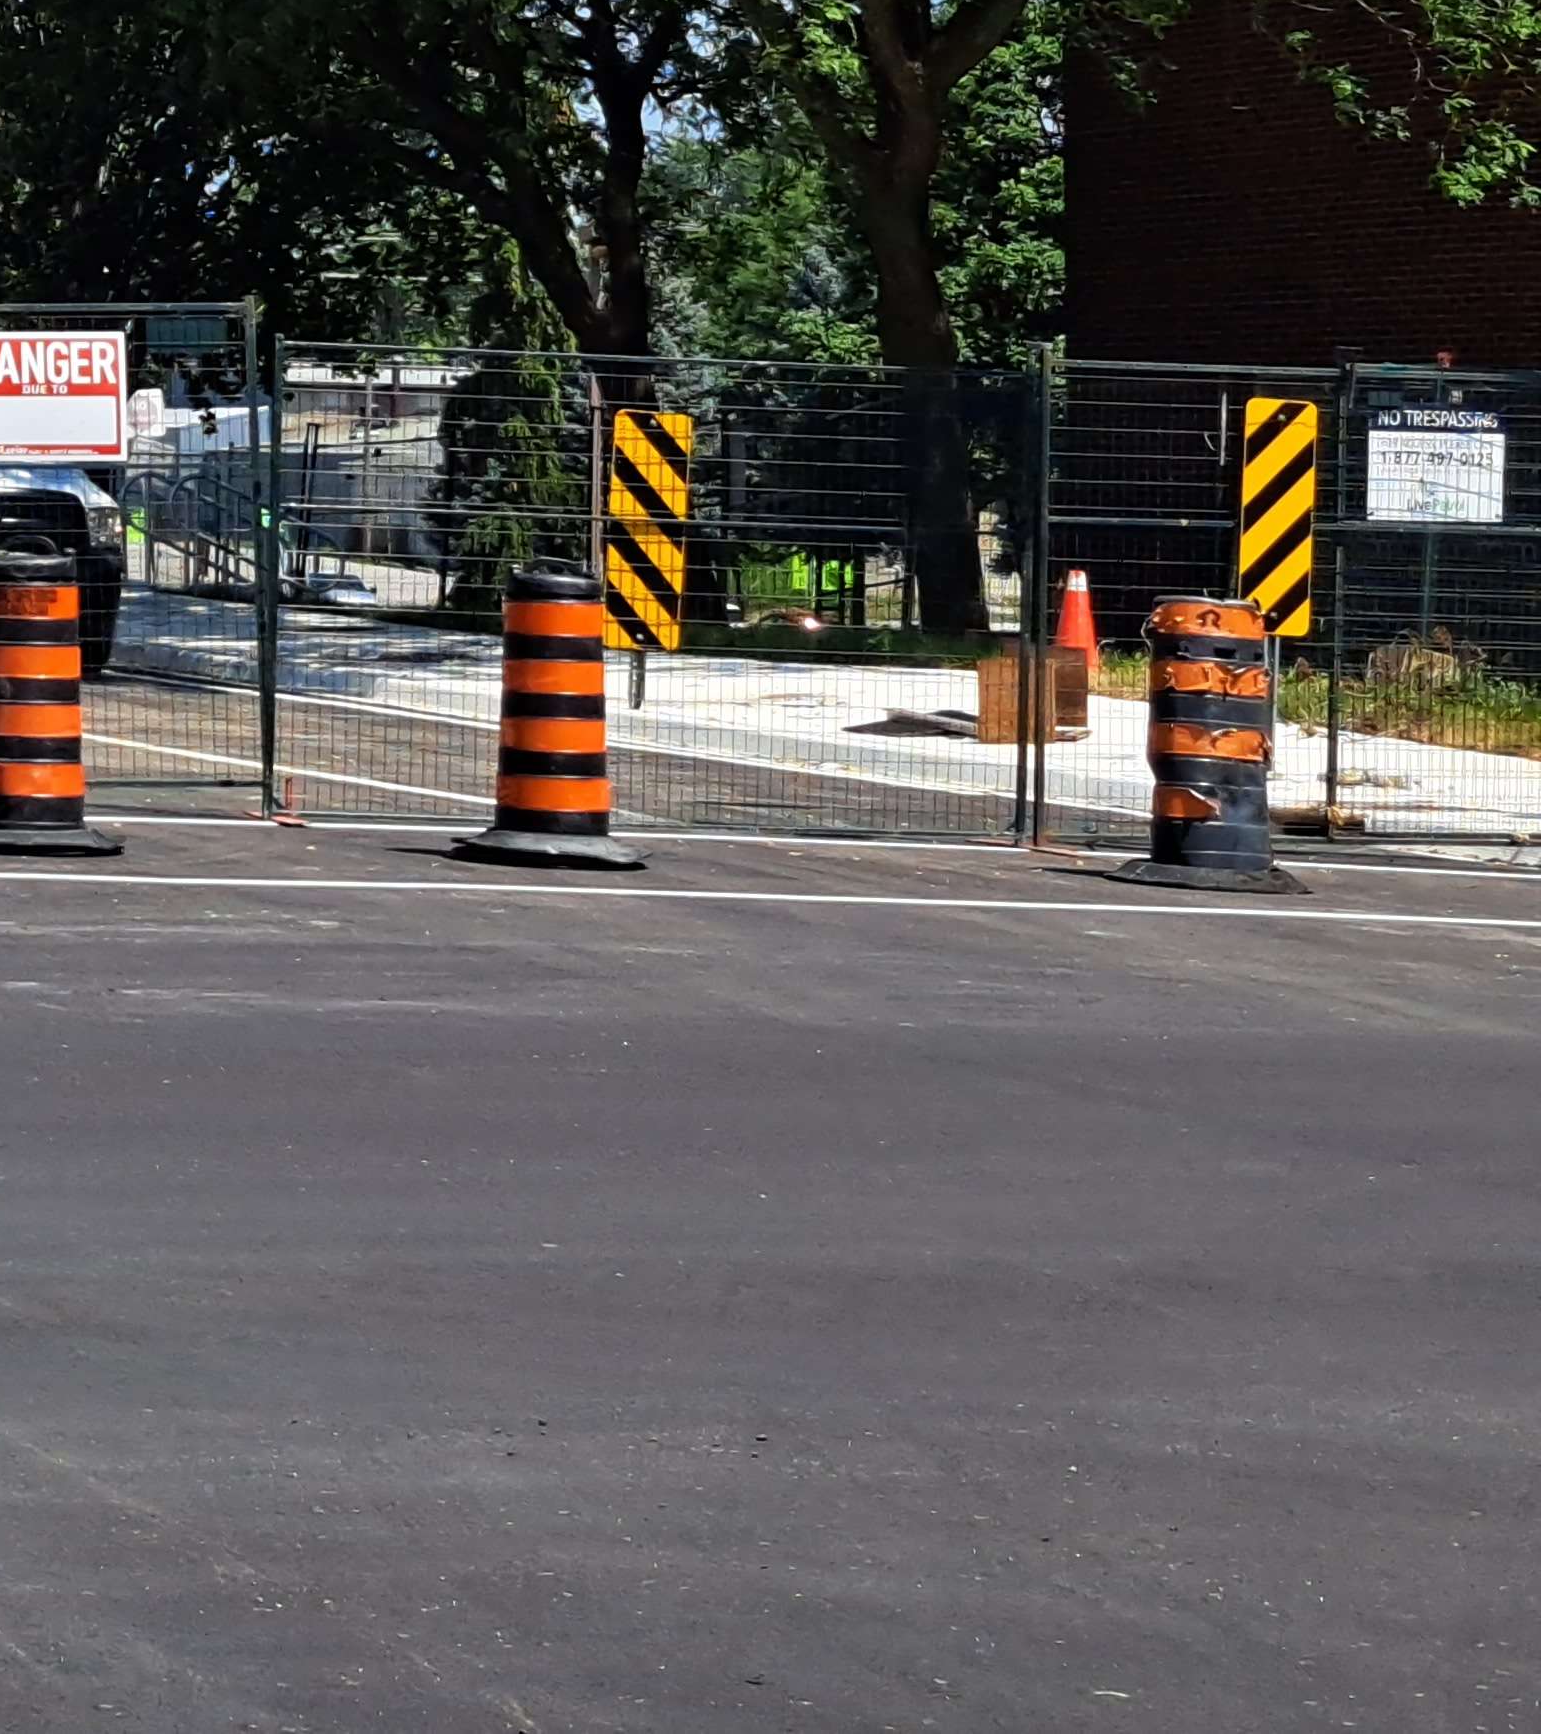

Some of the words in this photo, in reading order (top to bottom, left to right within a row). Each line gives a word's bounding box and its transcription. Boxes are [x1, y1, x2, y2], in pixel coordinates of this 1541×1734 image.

[21, 384, 48, 395] DUE
[52, 384, 68, 395] TO
[1378, 409, 1401, 426] NO
